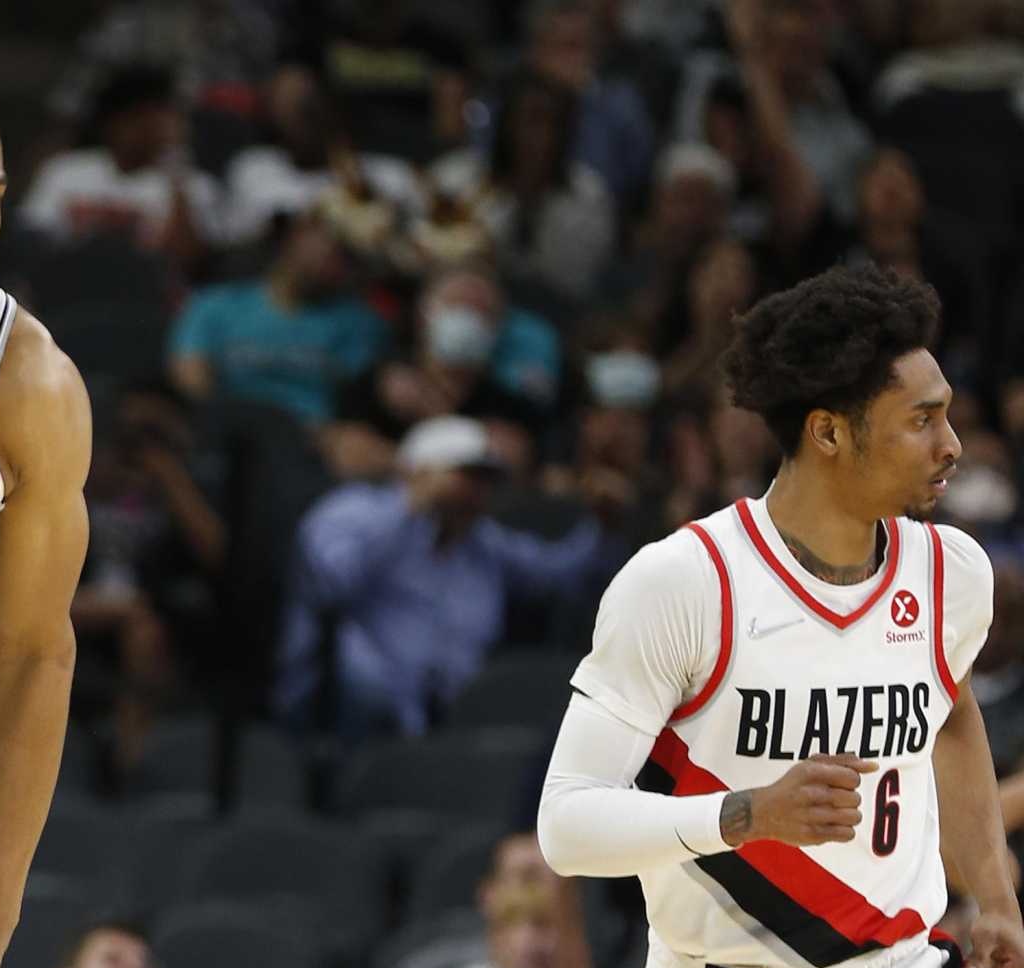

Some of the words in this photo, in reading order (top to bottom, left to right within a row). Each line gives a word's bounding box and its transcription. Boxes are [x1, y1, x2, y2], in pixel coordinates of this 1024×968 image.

[886, 630, 926, 644] StormX
[735, 682, 931, 761] BLAZERS
[871, 767, 901, 858] 6
